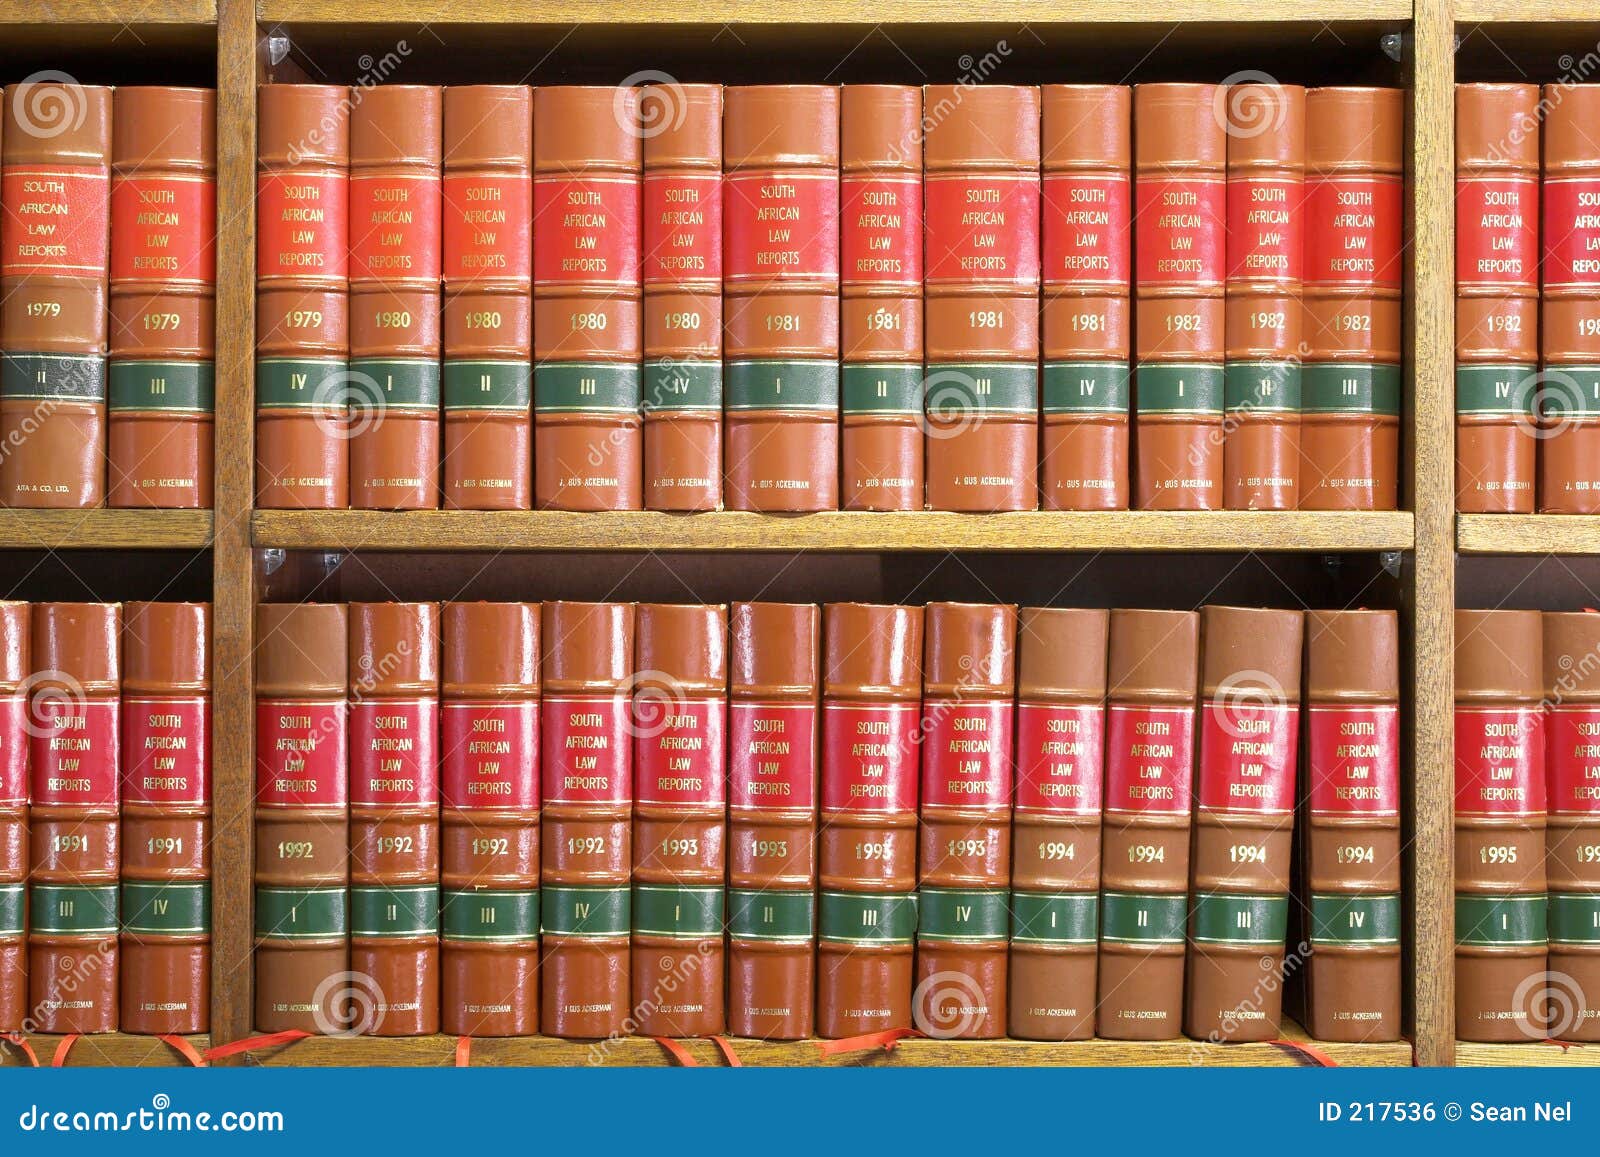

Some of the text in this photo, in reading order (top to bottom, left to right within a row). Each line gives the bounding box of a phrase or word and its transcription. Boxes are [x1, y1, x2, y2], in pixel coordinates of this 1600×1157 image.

[24, 182, 65, 194] SOUTH
[285, 187, 319, 200] SOUTH
[761, 185, 795, 198] SOUTH
[1252, 188, 1285, 201] SOUTH
[568, 192, 601, 205] SOUTH
[863, 192, 896, 205] SOUTH
[966, 190, 1000, 203] SOUTH
[1071, 189, 1105, 202] SOUTH
[1163, 192, 1196, 205] SOUTH
[1338, 193, 1372, 205] SOUTH
[1485, 192, 1519, 205] SOUTH
[19, 203, 68, 215] AFRICAN
[282, 209, 324, 222] AFRICAN
[758, 207, 799, 220] AFRICAN
[564, 214, 606, 228] AFRICAN
[858, 214, 900, 228] AFRICAN
[962, 212, 1004, 224] AFRICAN
[1067, 212, 1108, 224] AFRICAN
[1159, 215, 1200, 228] AFRICAN
[1248, 211, 1289, 223] AFRICAN
[1334, 215, 1375, 227] AFRICAN
[1481, 215, 1522, 227] AFRICAN
[28, 224, 55, 236] LAW
[769, 229, 790, 242] LAW
[292, 231, 314, 244] LAW
[575, 237, 596, 249] LAW
[870, 237, 890, 249] LAW
[974, 234, 995, 247] LAW
[1076, 234, 1097, 246] LAW
[1171, 237, 1192, 250] LAW
[1259, 233, 1280, 245] LAW
[1345, 237, 1366, 249] LAW
[1493, 237, 1513, 249] LAW
[19, 245, 67, 257] REPORTS
[280, 252, 323, 266] REPORTS
[757, 251, 799, 265] REPORTS
[962, 256, 1005, 269] REPORTS
[1065, 256, 1109, 269] REPORTS
[1246, 255, 1288, 268] REPORTS
[563, 258, 607, 272] REPORTS
[857, 258, 901, 272] REPORTS
[1158, 259, 1202, 273] REPORTS
[1331, 259, 1374, 272] REPORTS
[1478, 260, 1521, 273] REPORTS
[27, 303, 61, 317] 1979
[143, 314, 180, 330] 1979
[286, 311, 322, 329] 1979
[375, 312, 410, 328] 1980
[465, 312, 501, 328] 1980
[570, 313, 607, 330] 1980
[664, 313, 700, 329] 1980
[766, 315, 800, 331] 1981
[867, 313, 901, 330] 1981
[969, 312, 1003, 328] 1981
[1071, 315, 1105, 331] 1981
[1166, 315, 1201, 331] 1982
[1250, 313, 1285, 328] 1982
[1335, 316, 1370, 331] 1982
[1487, 316, 1521, 331] 1982
[151, 379, 165, 394] III
[291, 374, 307, 390] IV
[481, 376, 491, 391] II
[580, 379, 595, 394] III
[977, 380, 990, 395] III
[1080, 380, 1095, 395] IV
[1343, 380, 1357, 395] III
[1496, 382, 1509, 397] IV
[584, 478, 618, 486] ACKERMAN
[979, 477, 1013, 486] ACKERMAN
[1181, 480, 1212, 488] ACKERMAN
[149, 715, 181, 728] SOUTH
[375, 717, 407, 729] SOUTH
[570, 714, 602, 727] SOUTH
[665, 716, 696, 728] SOUTH
[1047, 720, 1079, 733] SOUTH
[1237, 720, 1270, 733] SOUTH
[1136, 722, 1169, 735] SOUTH
[1341, 723, 1374, 735] SOUTH
[145, 736, 186, 749] AFRICAN
[371, 738, 412, 751] AFRICAN
[566, 736, 607, 749] AFRICAN
[660, 737, 701, 750] AFRICAN
[1042, 743, 1083, 755] AFRICAN
[1232, 743, 1273, 755] AFRICAN
[1131, 744, 1173, 757] AFRICAN
[1336, 745, 1379, 757] AFRICAN
[154, 757, 175, 769] LAW
[381, 759, 401, 771] LAW
[576, 757, 596, 769] LAW
[670, 758, 690, 770] LAW
[1051, 764, 1072, 776] LAW
[1140, 766, 1162, 778] LAW
[1241, 764, 1262, 776] LAW
[1346, 767, 1368, 779] LAW
[143, 777, 187, 790] REPORTS
[370, 779, 413, 792] REPORTS
[565, 777, 607, 790] REPORTS
[658, 778, 701, 791] REPORTS
[1040, 784, 1083, 797] REPORTS
[1129, 786, 1173, 799] REPORTS
[1230, 784, 1273, 797] REPORTS
[1336, 787, 1380, 799] REPORTS
[53, 836, 88, 852] 1991
[148, 838, 182, 854] 1991
[278, 842, 313, 858] 1992
[377, 837, 412, 853] 1992
[473, 839, 508, 855] 1992
[568, 838, 604, 854] 1992
[662, 839, 697, 855] 1993
[752, 841, 787, 857] 1993
[949, 841, 985, 856] 1993
[1039, 844, 1074, 860] 1994
[1128, 847, 1164, 863] 1994
[1230, 846, 1266, 862] 1994
[1337, 847, 1374, 863] 1994
[1480, 847, 1516, 863] 1995
[154, 901, 167, 915] IV
[576, 903, 589, 918] IV
[481, 908, 495, 923] III
[1138, 911, 1147, 927] II
[1237, 912, 1251, 927] III
[1349, 912, 1364, 927] IV
[1137, 1011, 1167, 1019] ACKERMAN
